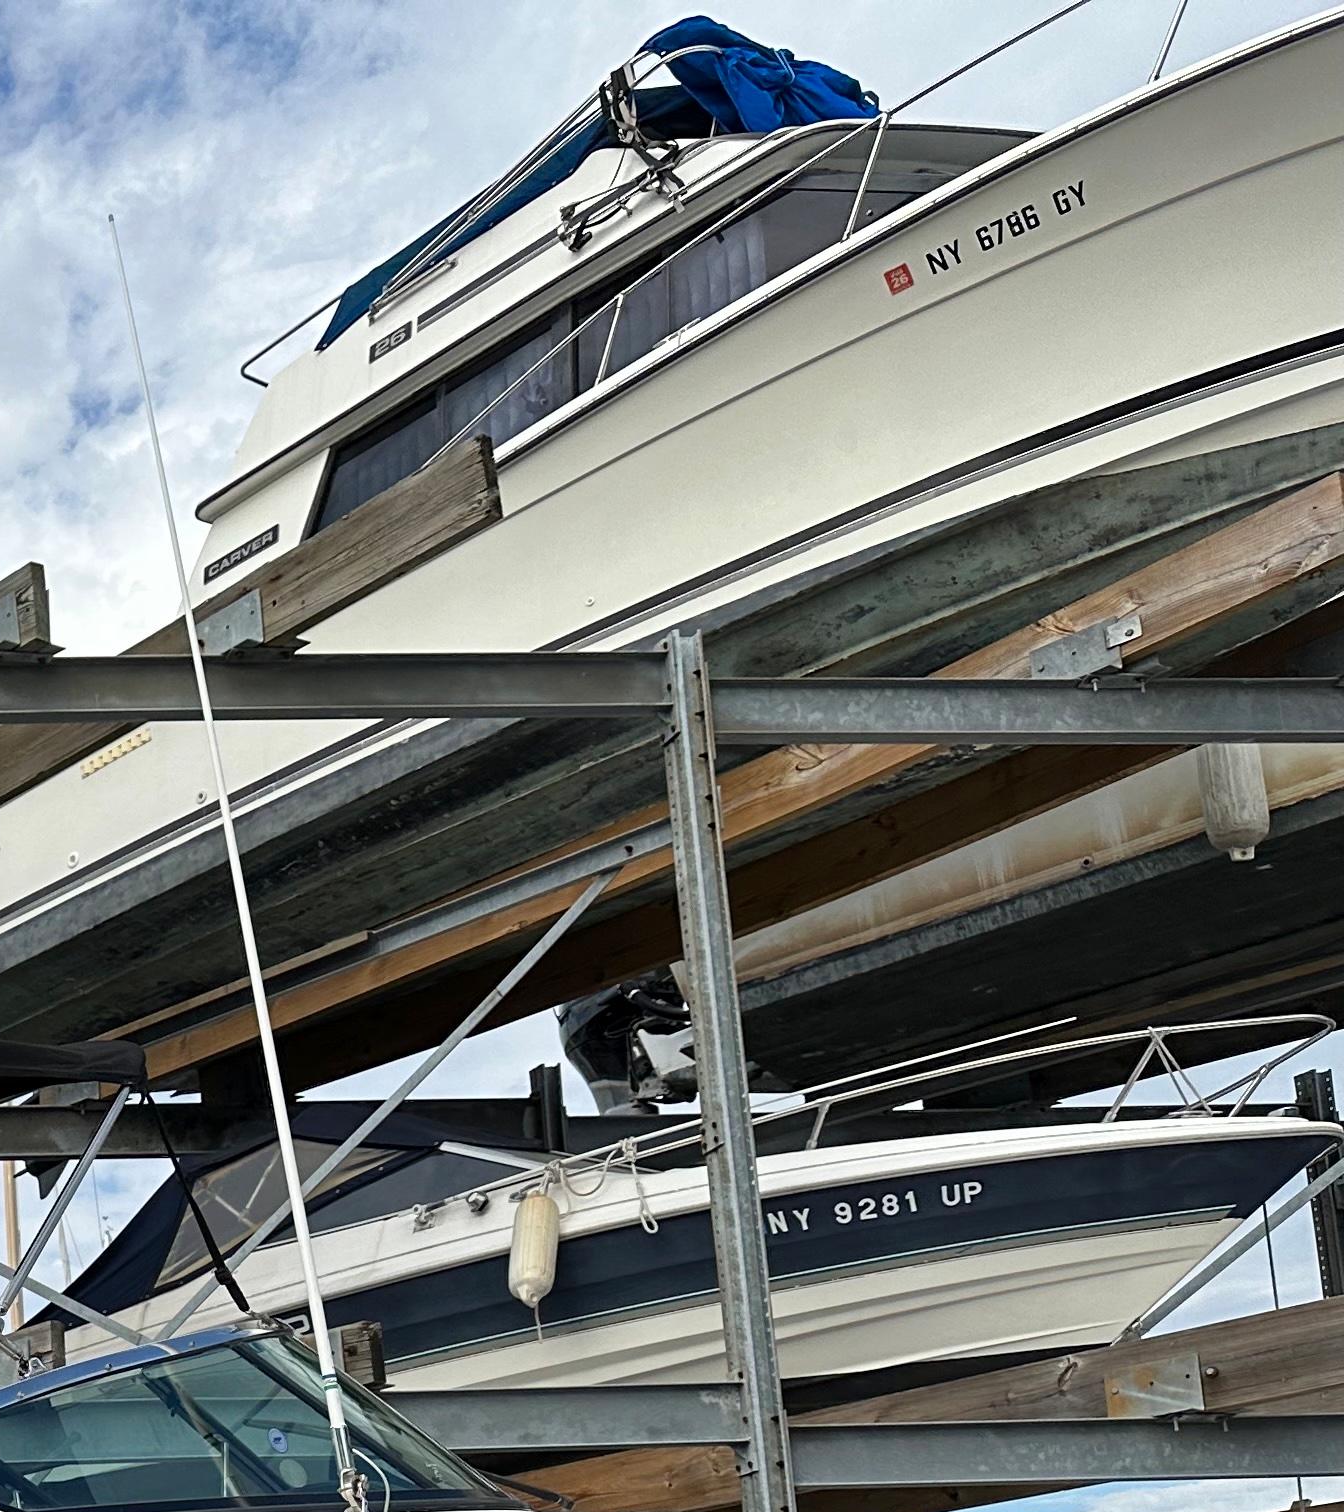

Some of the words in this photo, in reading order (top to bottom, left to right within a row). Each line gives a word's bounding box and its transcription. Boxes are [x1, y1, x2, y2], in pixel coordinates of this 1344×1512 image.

[925, 238, 962, 275] NY
[975, 204, 1041, 251] 6786
[1052, 180, 1086, 215] GY
[374, 327, 406, 358] 26
[208, 530, 274, 578] CARVER
[766, 1208, 810, 1235] NY
[833, 1190, 919, 1225] 9281
[940, 1181, 983, 1207] UP
